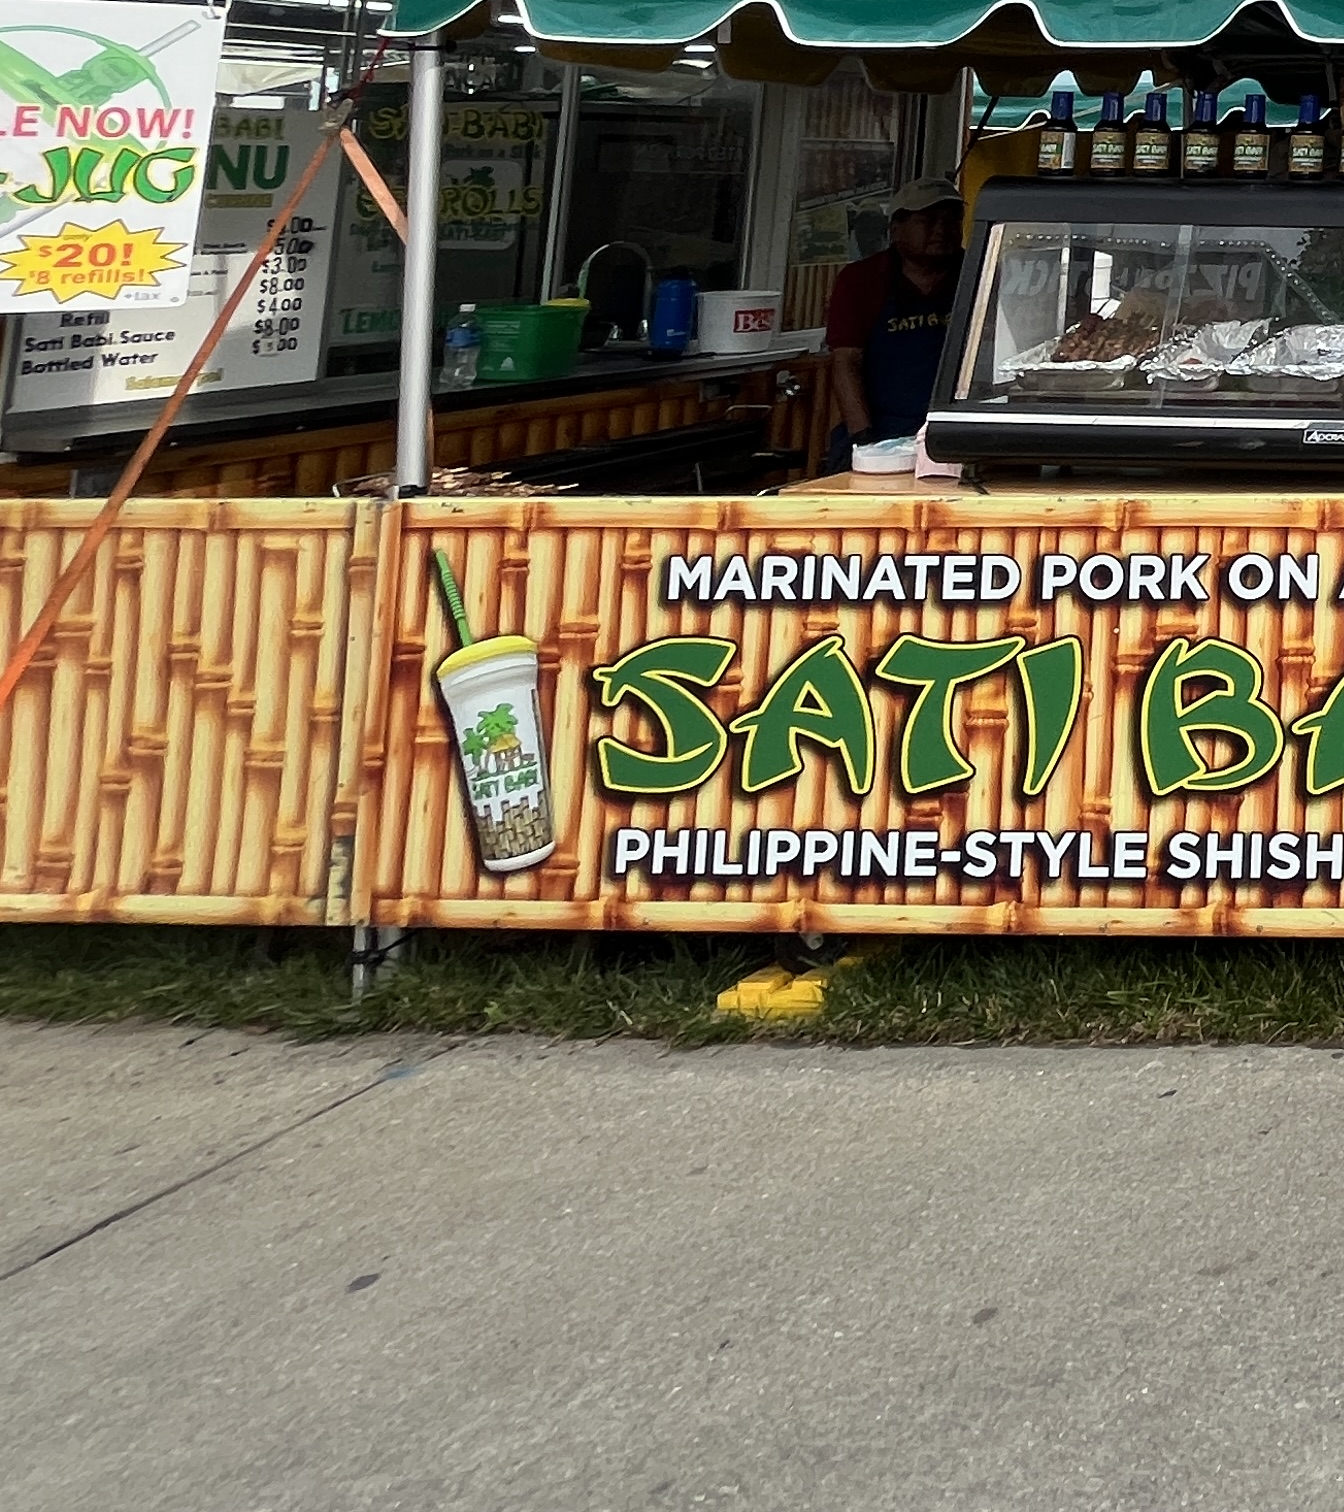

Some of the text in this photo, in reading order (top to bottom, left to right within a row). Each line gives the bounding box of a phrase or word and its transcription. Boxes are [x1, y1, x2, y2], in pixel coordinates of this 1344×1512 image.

[56, 105, 195, 139] NOW!
[39, 242, 134, 268] $20!
[60, 268, 145, 284] refills!
[60, 311, 110, 327] Refill
[120, 330, 176, 345] Sauce
[21, 352, 159, 376] Bottled Water
[667, 553, 1021, 601] MARINATED
[1042, 553, 1210, 600] PORK
[1229, 552, 1321, 600] ON
[594, 632, 1083, 795] SATI
[614, 829, 1147, 879] PHILIPPINE-STYLE
